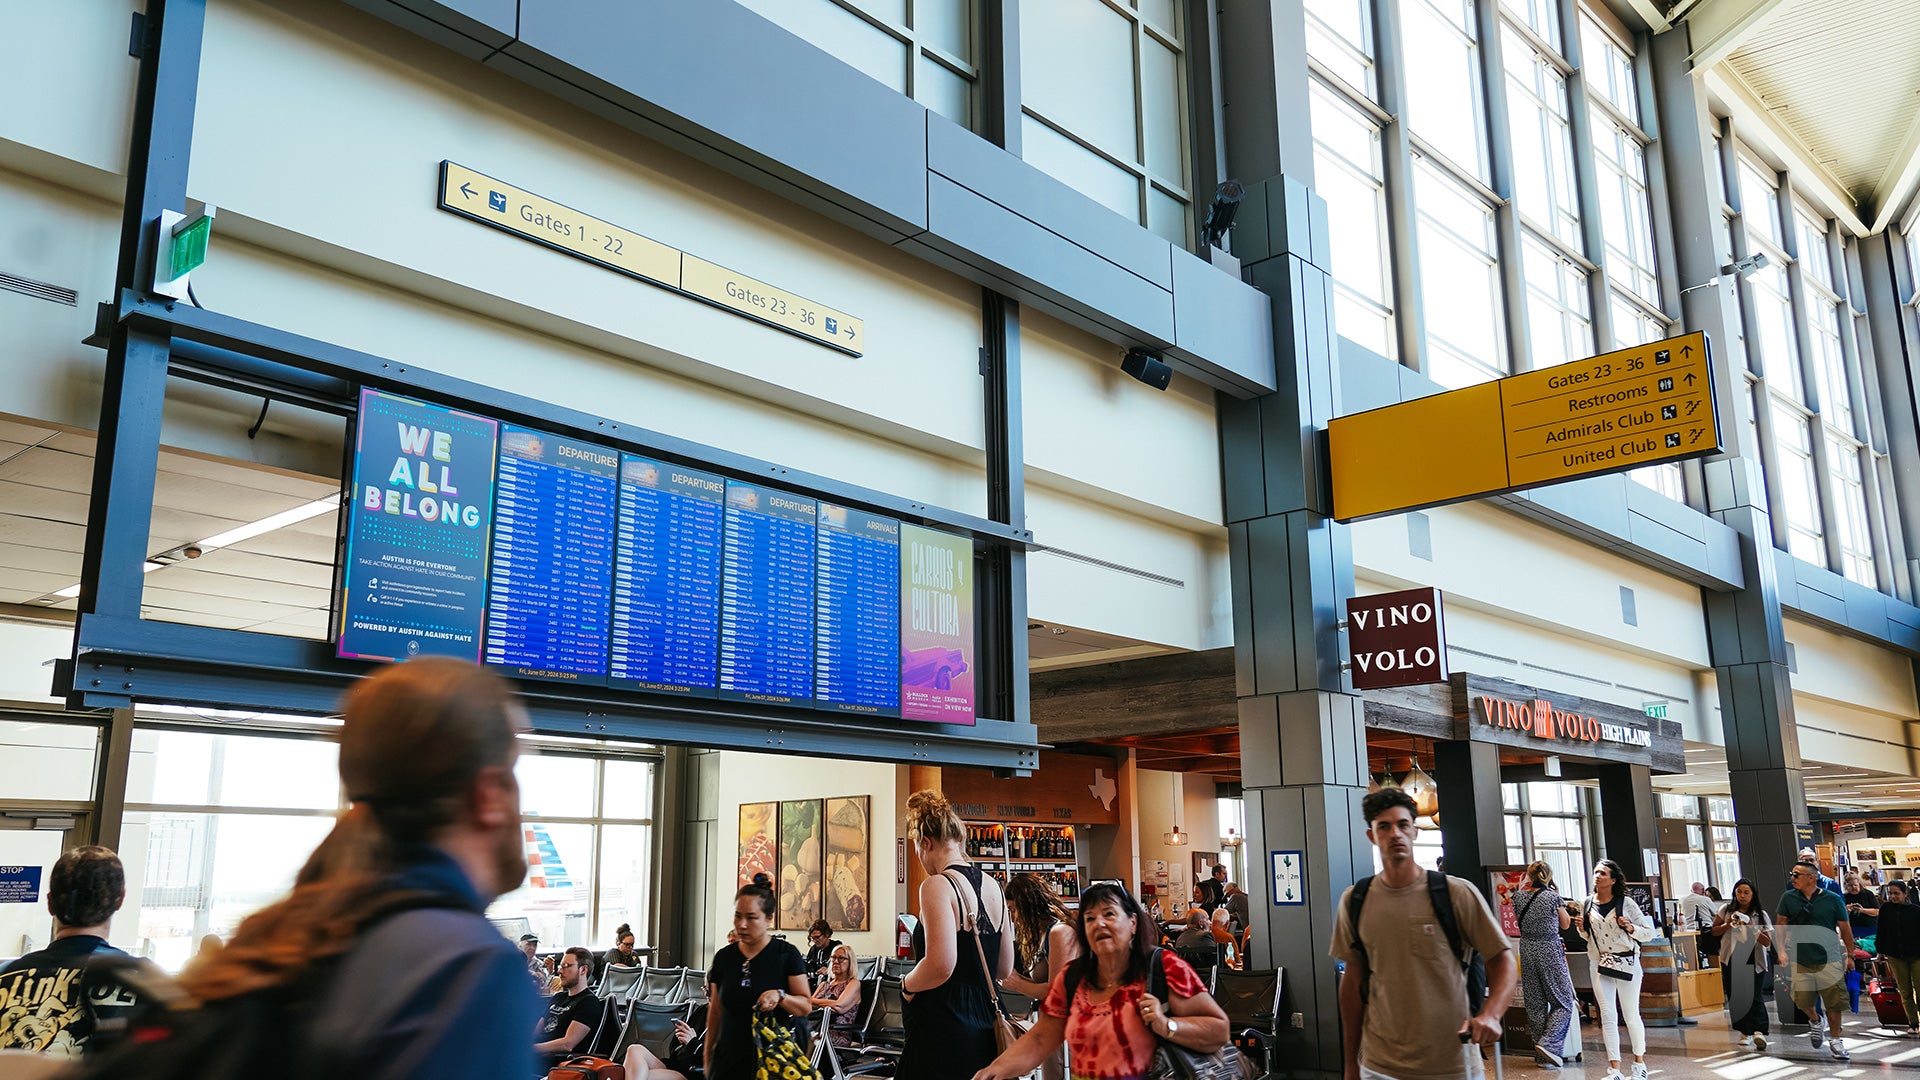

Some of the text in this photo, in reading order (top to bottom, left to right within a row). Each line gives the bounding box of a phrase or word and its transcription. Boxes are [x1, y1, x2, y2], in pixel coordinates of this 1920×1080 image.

[520, 203, 571, 237] Gates
[578, 225, 585, 242] 1
[604, 235, 625, 257] 22
[726, 281, 766, 310] Gates
[770, 297, 787, 316] 23
[800, 307, 816, 327] 36
[1547, 370, 1590, 390] Gates
[1594, 363, 1612, 380] 23
[1626, 356, 1644, 373] 36
[1568, 383, 1649, 412] Restrooms
[1545, 409, 1654, 444] Admirals Club
[398, 422, 452, 463] WE
[558, 445, 618, 468] DEPARTURES
[1562, 438, 1657, 468] United Club
[389, 457, 458, 497] ALL
[671, 473, 724, 494] DEPARTURES
[364, 485, 481, 529] BELONG
[769, 497, 816, 515] DEPARTURES
[866, 520, 898, 535] ARRIVALS
[373, 560, 392, 568] ACTION
[382, 554, 405, 563] AUSTIN
[426, 561, 457, 572] EVERYONE
[911, 541, 954, 591] CARROS
[911, 586, 960, 637] CULTURA
[1351, 602, 1432, 631] VINO
[353, 622, 387, 632] POWERED
[398, 627, 424, 636] AUSTIN
[424, 631, 453, 640] AGAINST
[1354, 646, 1436, 674] VOLO
[1480, 696, 1652, 748] VINO VOLO HIGH PLAINS
[1647, 705, 1667, 718] EXIT
[1052, 808, 1072, 818] TEXAS
